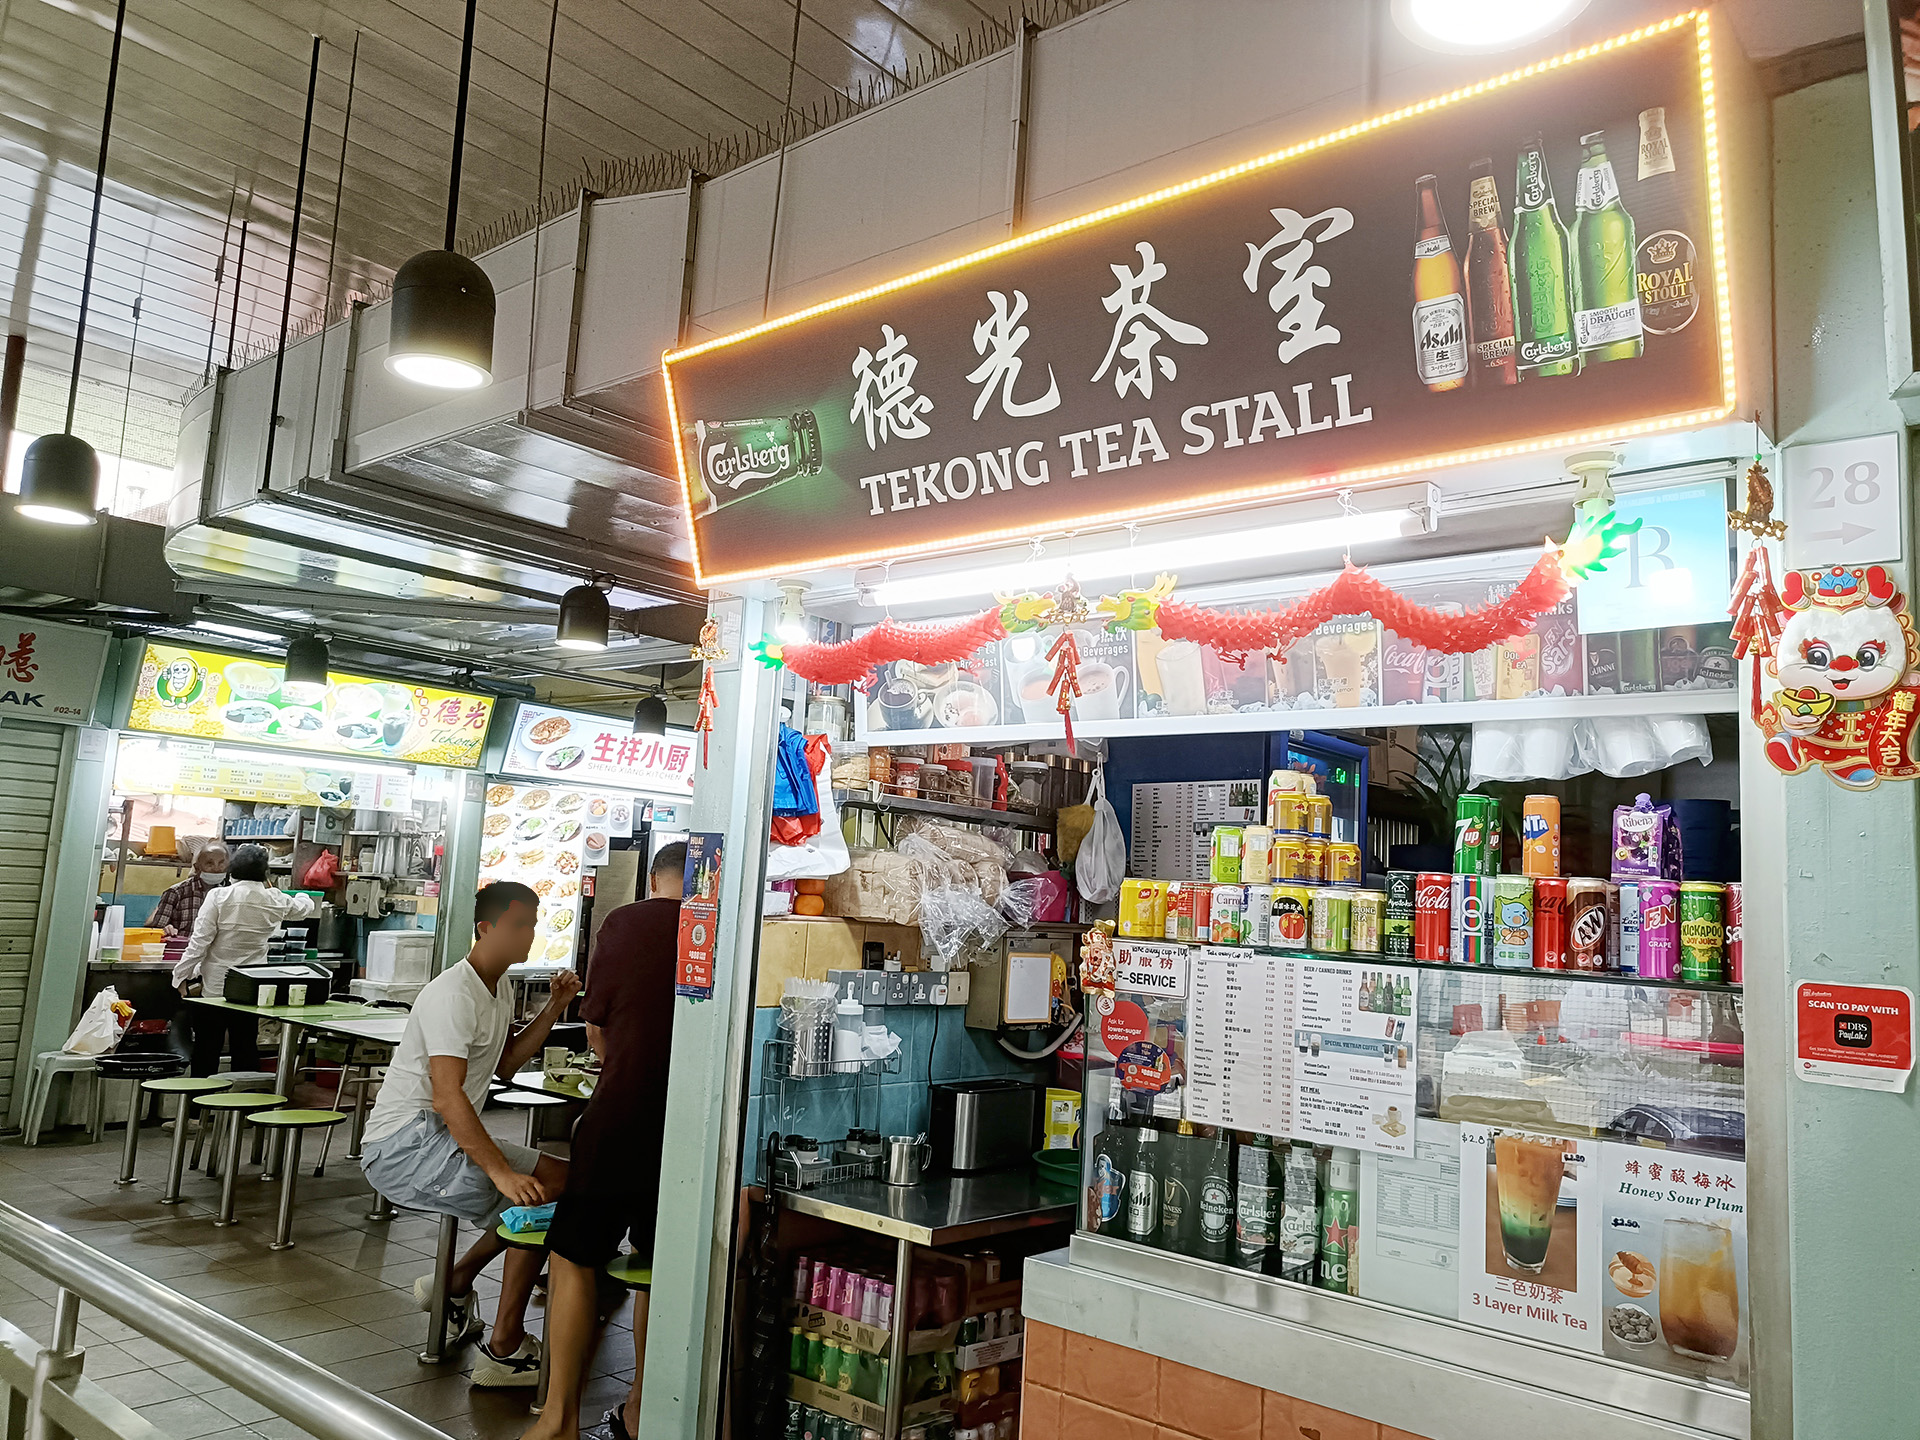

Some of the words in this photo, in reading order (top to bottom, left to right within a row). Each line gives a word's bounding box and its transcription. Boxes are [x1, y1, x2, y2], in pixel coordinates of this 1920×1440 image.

[1524, 151, 1543, 207] Carlsberg
[1469, 196, 1499, 209] SPECIAL
[1473, 205, 1495, 217] BREW
[1637, 262, 1693, 293] ROYAL
[1645, 283, 1686, 304] STOUT
[1589, 307, 1619, 317] SMOOTH
[1590, 308, 1636, 325] DRAUGHT
[850, 207, 1354, 450] 德光茶室
[1420, 322, 1463, 351] Asahi
[1477, 339, 1514, 353] SPECIAL
[1482, 347, 1510, 360] BREW
[1521, 341, 1573, 360] Carlsberg
[860, 441, 1050, 516] TEKONG
[1059, 418, 1169, 478] TEA
[1180, 374, 1373, 455] STALL
[707, 441, 790, 486] Carlsberg
[1808, 461, 1880, 509] 28
[1316, 620, 1374, 636] Beverages
[1083, 644, 1129, 657] Beverages
[1541, 620, 1579, 675] Sarsi
[1319, 686, 1335, 694] Honey
[1621, 681, 1656, 692] Carlsberg
[433, 697, 486, 729] 德光
[1879, 690, 1917, 766] 龍年大吉
[430, 728, 482, 758] Tekong
[591, 733, 690, 773] 生祥小厨
[588, 762, 617, 773] SHENG
[619, 767, 644, 777] XIANG
[645, 772, 682, 781] KITCHEN
[468, 779, 481, 790] 16
[1622, 816, 1653, 828] Ribena
[1455, 818, 1472, 850] 7
[1465, 831, 1479, 842] up
[1418, 885, 1450, 909] Cola
[1644, 903, 1677, 930] F&N
[1682, 924, 1722, 937] KICKAPOO
[1649, 941, 1672, 949] GRAPE
[1698, 938, 1718, 946] JUICE
[1808, 1000, 1834, 1009] SCAN
[1836, 1003, 1849, 1011] TO
[1851, 1004, 1870, 1012] PAY
[1871, 1006, 1899, 1015] WITH
[1107, 1025, 1142, 1035] lower-sugar
[1848, 1022, 1868, 1031] DBS
[1625, 1160, 1736, 1192] 蜂蜜酸梅冰
[1618, 1182, 1663, 1201] Honey
[1667, 1189, 1701, 1207] Sour
[1704, 1196, 1744, 1213] Plum
[1495, 1276, 1564, 1305] 三色奶茶
[1472, 1293, 1480, 1305] 3
[1485, 1296, 1524, 1316] Layer
[1526, 1303, 1558, 1324] Milk
[1562, 1313, 1588, 1331] Tea
